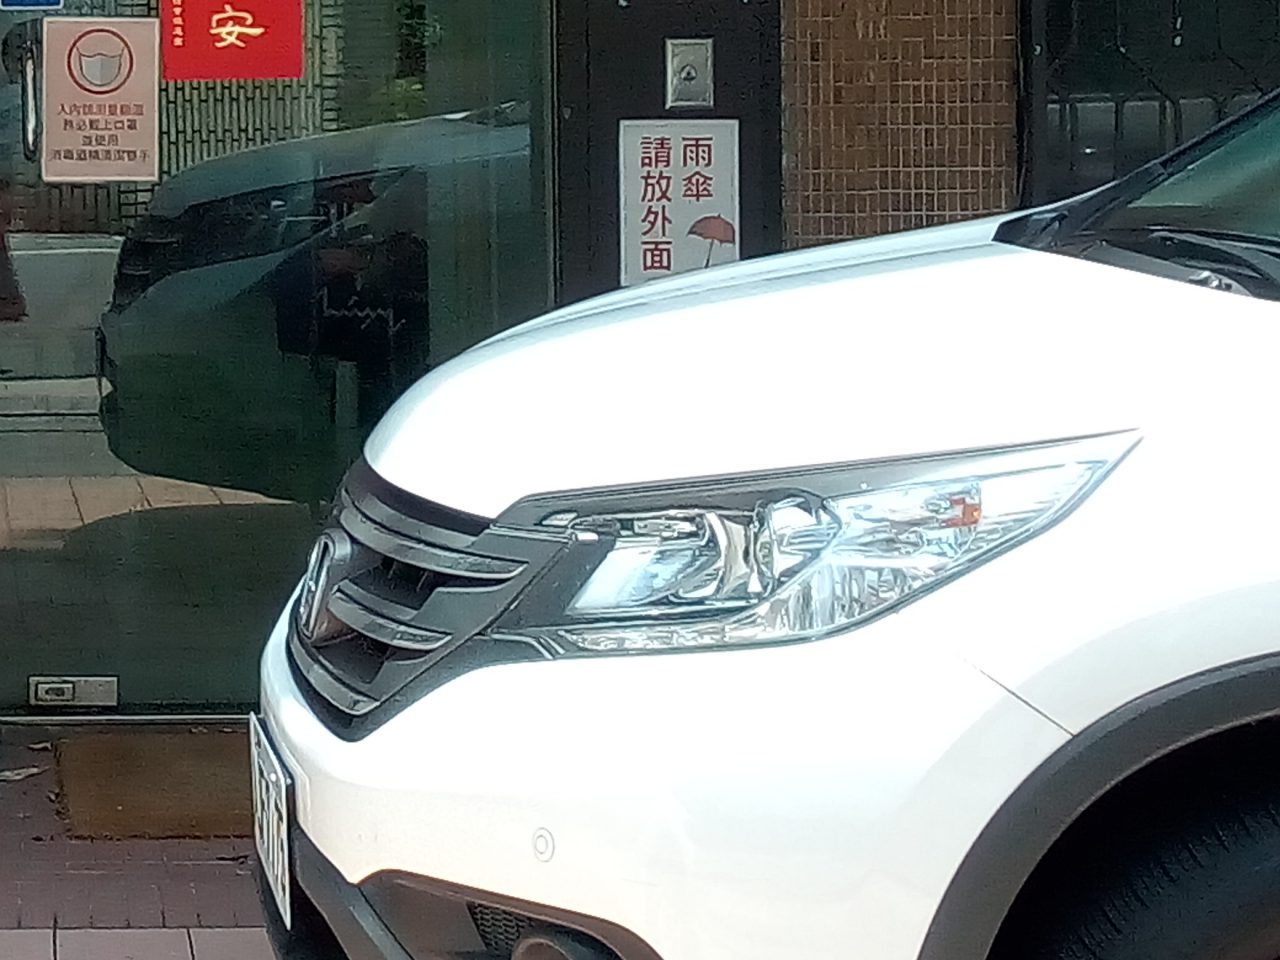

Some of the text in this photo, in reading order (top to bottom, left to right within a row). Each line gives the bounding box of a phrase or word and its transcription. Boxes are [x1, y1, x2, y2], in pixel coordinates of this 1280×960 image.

[640, 136, 673, 272] 請放外面
[681, 136, 714, 203] 雨傘
